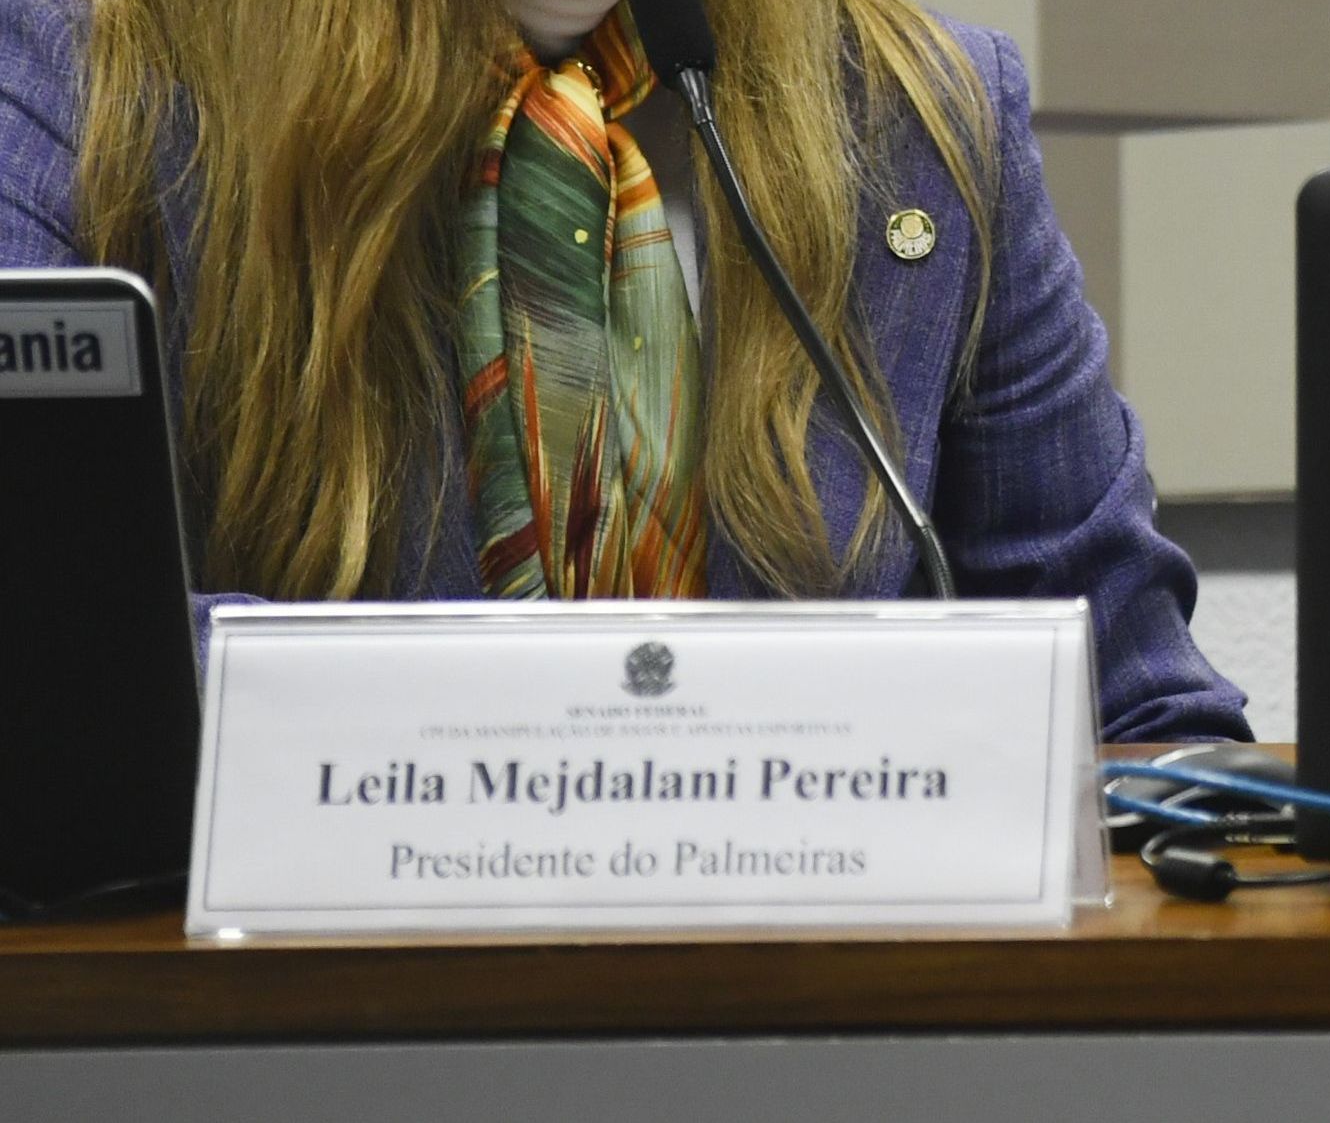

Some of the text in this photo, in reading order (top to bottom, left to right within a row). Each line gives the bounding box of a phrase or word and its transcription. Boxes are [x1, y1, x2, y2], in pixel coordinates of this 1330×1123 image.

[317, 757, 949, 815] Leila Mejdalani Pereira
[390, 840, 867, 879] Presidente do Palmeiras
